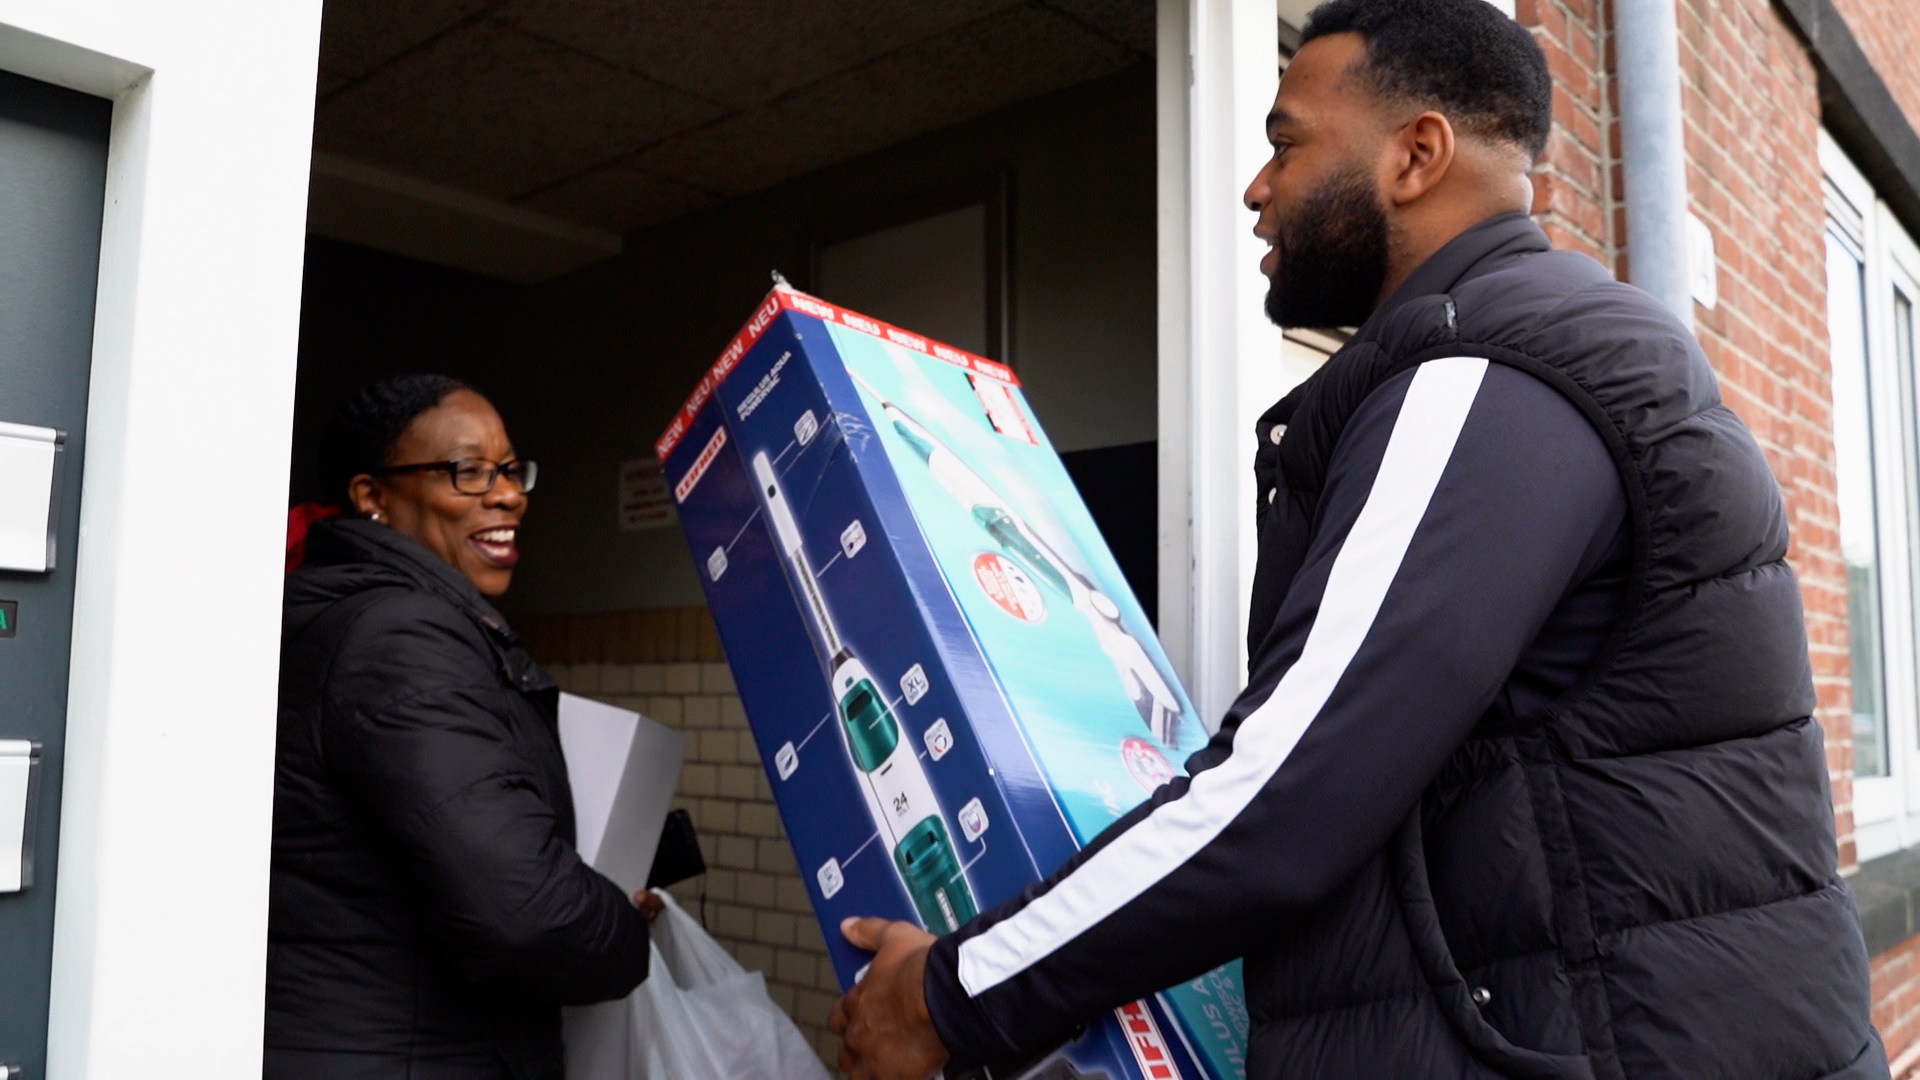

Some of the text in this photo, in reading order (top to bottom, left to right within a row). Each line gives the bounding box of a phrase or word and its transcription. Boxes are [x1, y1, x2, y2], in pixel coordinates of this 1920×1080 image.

[790, 295, 835, 320] NEW
[842, 313, 881, 335] NEU
[887, 330, 928, 352] NEW
[933, 345, 969, 367] NEU
[657, 297, 779, 457] NEW NEU NEW NEU
[906, 676, 922, 692] XL
[892, 790, 910, 812] 24
